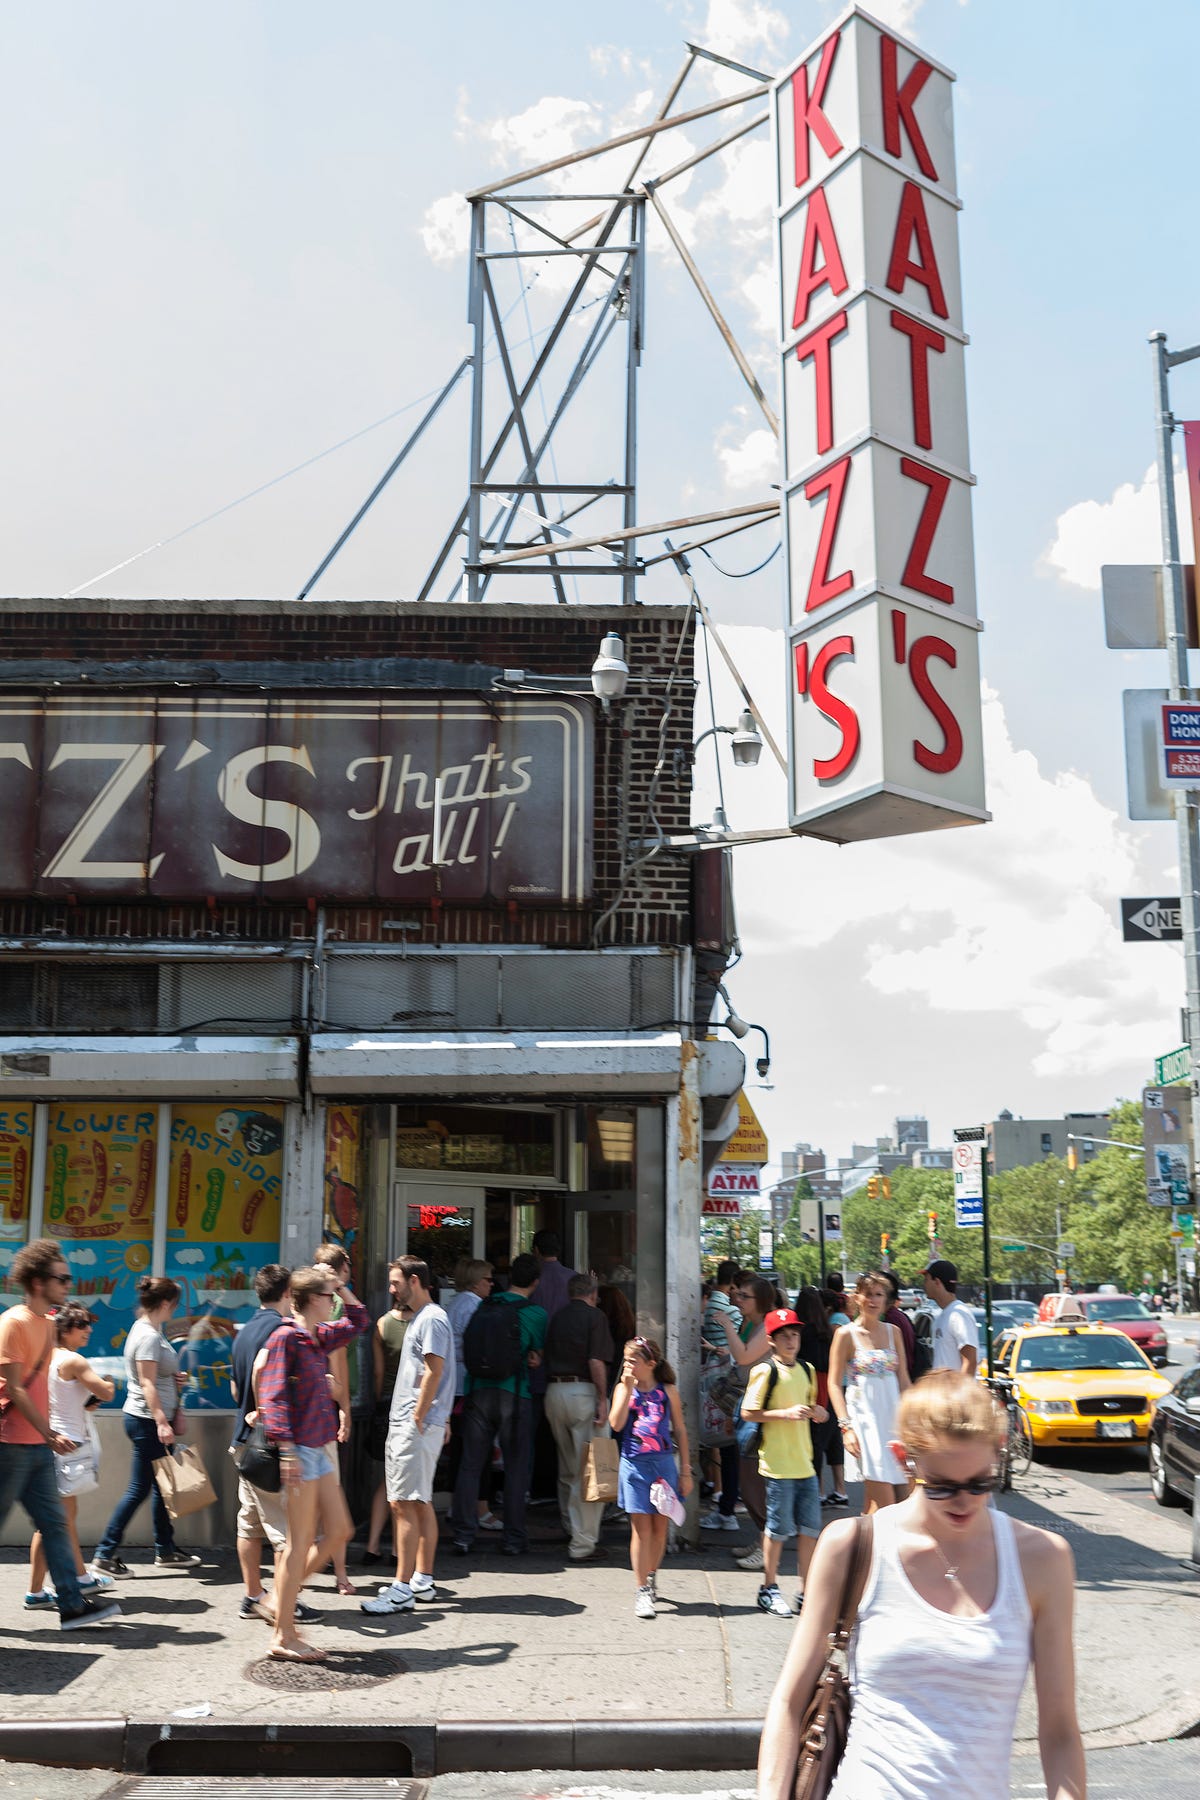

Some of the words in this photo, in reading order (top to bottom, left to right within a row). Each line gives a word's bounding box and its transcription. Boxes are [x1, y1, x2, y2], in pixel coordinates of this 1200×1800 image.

[791, 31, 861, 781] KATZ'S
[880, 34, 963, 775] KATZ'S
[346, 742, 532, 821] That's
[392, 801, 518, 874] all!
[1143, 911, 1182, 928] ONE
[170, 1118, 231, 1157] EAST
[726, 1142, 766, 1153] ESTAURANT
[711, 1175, 759, 1190] ATM
[702, 1199, 740, 1213] ATM
